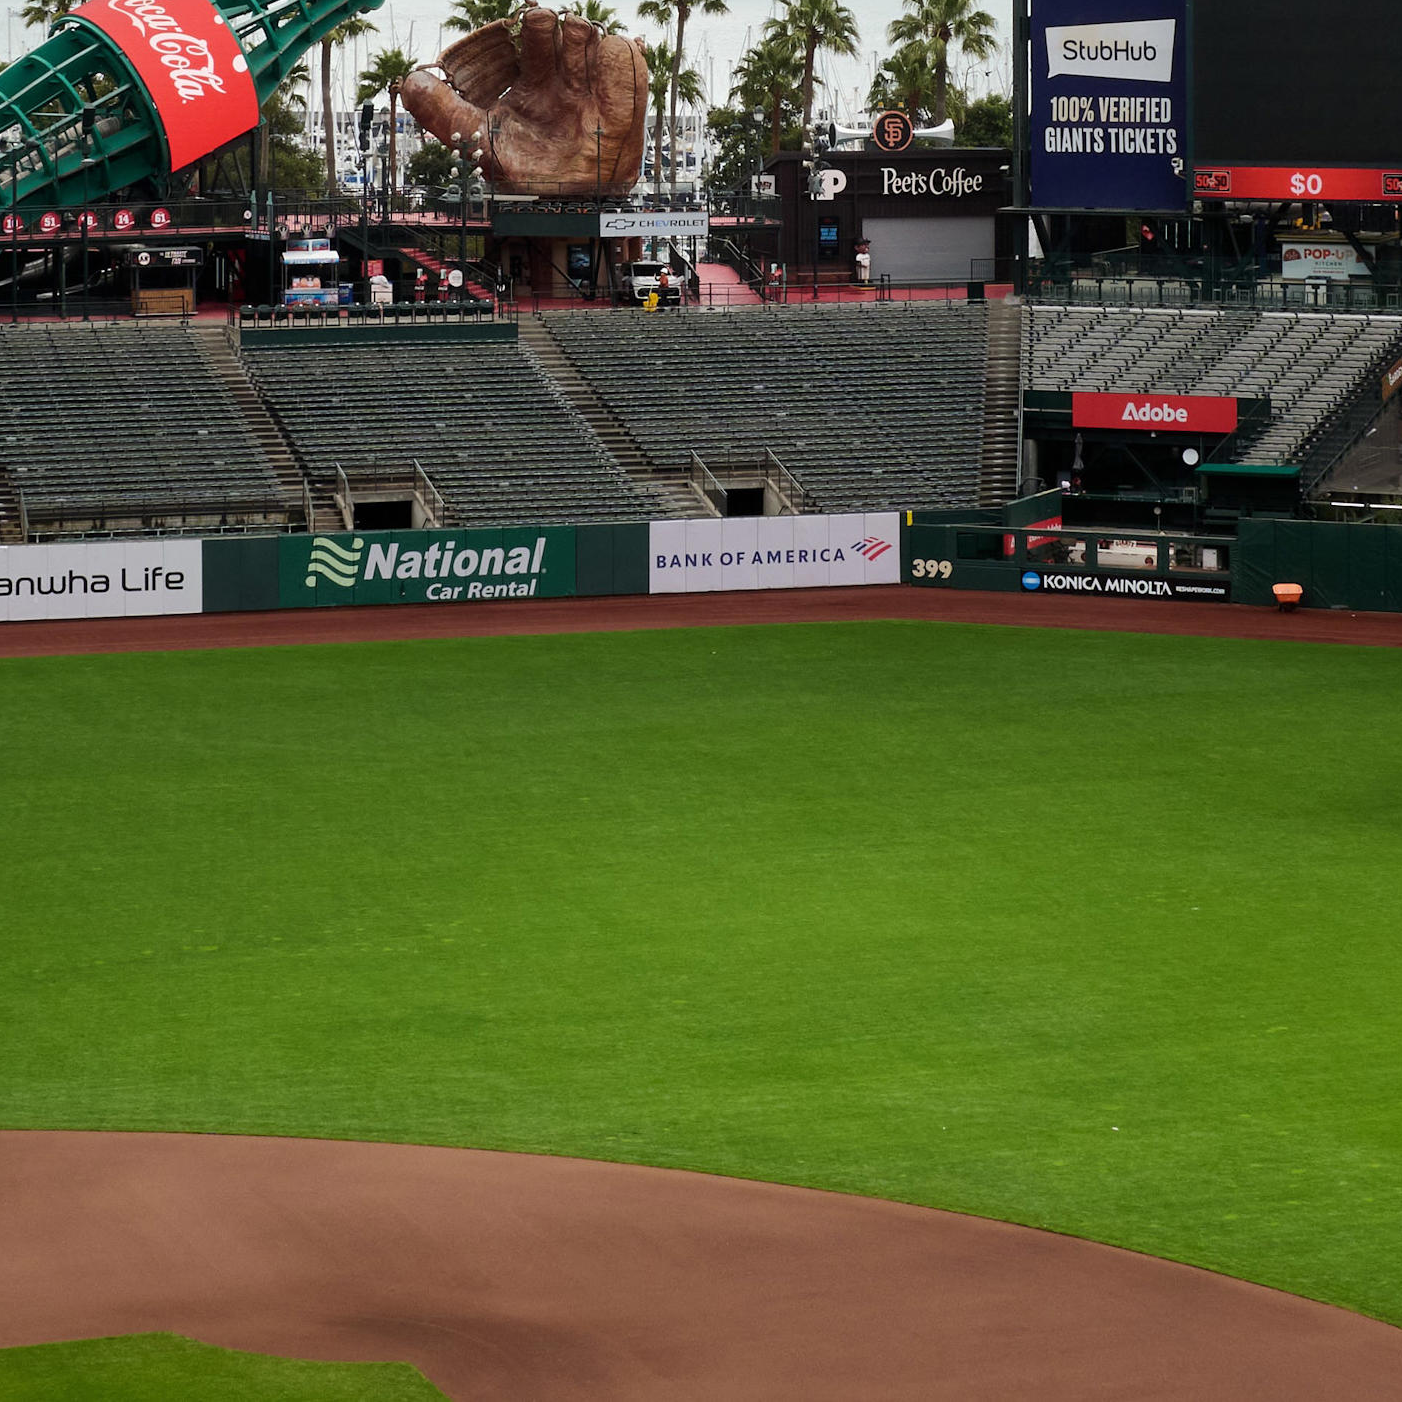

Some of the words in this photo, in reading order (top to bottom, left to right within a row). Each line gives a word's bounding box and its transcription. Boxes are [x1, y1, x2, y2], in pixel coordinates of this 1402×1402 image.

[1063, 40, 1157, 61] StubHub
[1050, 97, 1095, 123] 100%
[1099, 97, 1172, 123] VERIFIED
[1045, 127, 1105, 153] GIANTS
[1108, 128, 1177, 154] TICKETS
[880, 167, 927, 196] Peet's
[929, 167, 983, 198] Coffee
[1290, 172, 1323, 196] $0
[118, 214, 129, 224] 14
[154, 213, 166, 223] 61
[639, 219, 705, 227] CHEVROLET
[1122, 402, 1188, 423] Adobe
[364, 537, 547, 581] National
[657, 553, 712, 569] BANK
[720, 551, 745, 566] OF
[751, 548, 845, 565] AMERICA
[911, 558, 953, 579] 399
[122, 566, 184, 592] Life
[426, 582, 460, 600] Car
[467, 578, 537, 599] Rental
[1043, 574, 1102, 591] KONICA
[1105, 578, 1172, 596] MINOLTA
